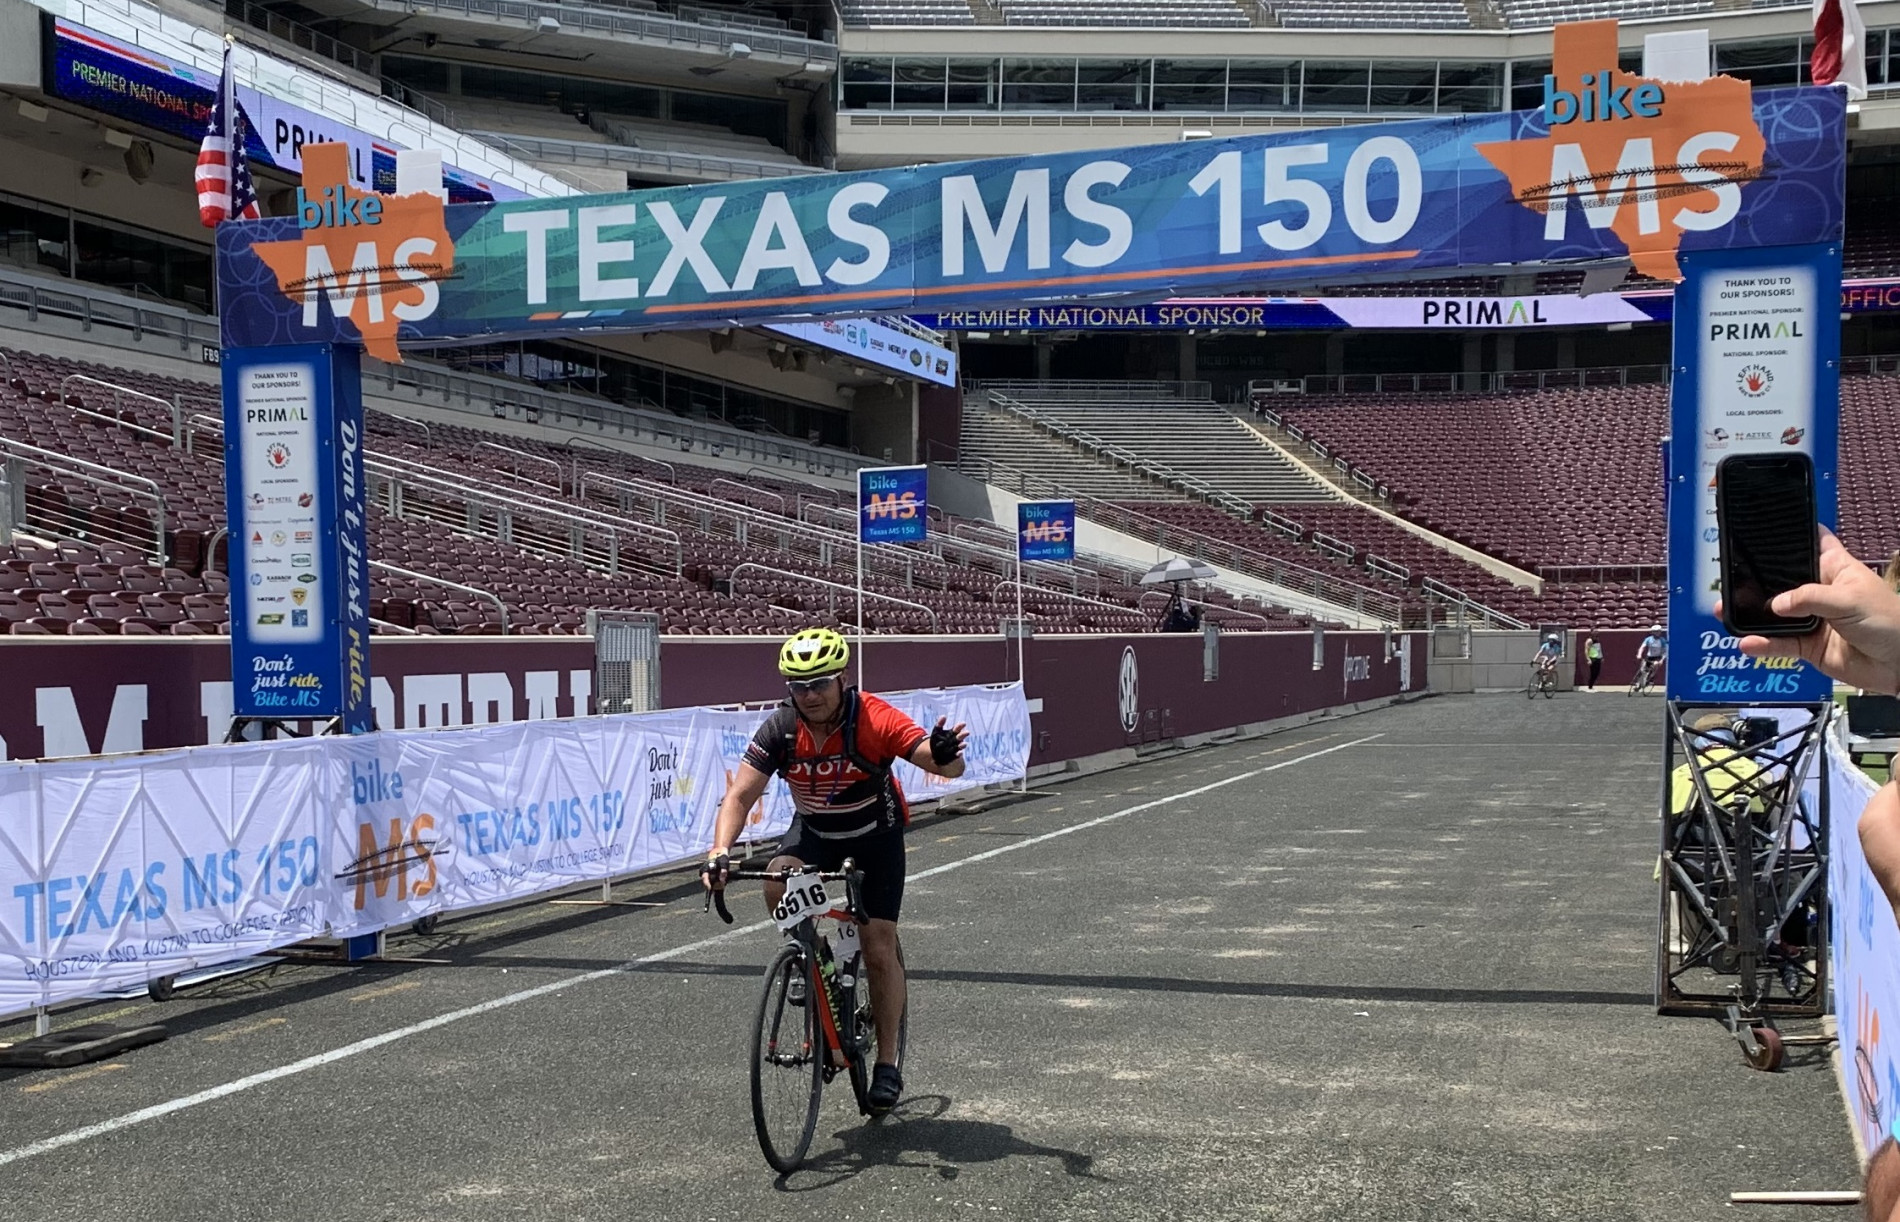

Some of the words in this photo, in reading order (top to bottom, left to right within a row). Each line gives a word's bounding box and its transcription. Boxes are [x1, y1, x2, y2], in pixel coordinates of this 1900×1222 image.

[72, 60, 126, 96] PREMIER
[130, 80, 191, 118] NATIONAL
[1543, 71, 1664, 126] bike
[1544, 131, 1742, 241] MS
[297, 184, 382, 229] bike
[503, 182, 891, 305] TEXAS
[941, 160, 1133, 277] MS
[1188, 136, 1423, 256] 150
[303, 237, 440, 327] MS
[1720, 291, 1740, 299] OUR
[1742, 288, 1795, 298] SPONSORS!
[1725, 279, 1756, 287] THANK
[1757, 278, 1776, 286] YOU
[1778, 277, 1791, 285] TO
[938, 308, 1031, 326] PREMIER
[1039, 308, 1152, 326] NATIONAL
[1159, 307, 1264, 325] SPONSOR
[1423, 300, 1547, 325] PRIMAL
[1710, 321, 1803, 341] PRIMAL
[1755, 349, 1788, 357] SPONSOR:
[254, 372, 275, 380] THANK
[276, 371, 289, 379] YOU
[1736, 364, 1751, 383] LEFT
[1752, 364, 1774, 382] HAND
[247, 407, 308, 423] PRIMAL
[341, 419, 363, 530] Don't
[869, 476, 898, 489] bike
[869, 492, 916, 520] MS
[1026, 507, 1050, 518] bike
[869, 528, 888, 536] Texas
[888, 527, 901, 535] MS
[901, 526, 916, 534] 150
[1026, 520, 1065, 543] MS
[1052, 547, 1065, 555] 150
[341, 531, 364, 621] just
[252, 654, 294, 672] Don't
[1696, 652, 1750, 675] just
[251, 673, 287, 692] just
[288, 672, 323, 690] ride,
[1698, 674, 1751, 693] Bike
[1755, 672, 1801, 694] MS
[253, 691, 289, 707] Bike
[291, 690, 320, 707] MS
[649, 741, 678, 773] Don't
[788, 759, 862, 777] OYOTA
[352, 758, 403, 805] bike
[649, 774, 674, 810] just
[458, 803, 541, 857] TEXAS
[548, 797, 582, 841] MS
[590, 789, 624, 835] 150
[354, 813, 437, 910] MS
[554, 855, 566, 869] TO
[566, 849, 598, 868] COLLEGE
[14, 861, 168, 944] TEXAS
[182, 848, 243, 912] MS
[256, 836, 319, 895] 150
[24, 956, 101, 981] HOUSTON
[108, 947, 138, 964] AND
[142, 934, 191, 957] AUSTIN
[192, 928, 213, 945] TO
[214, 915, 271, 943] COLLEGE
